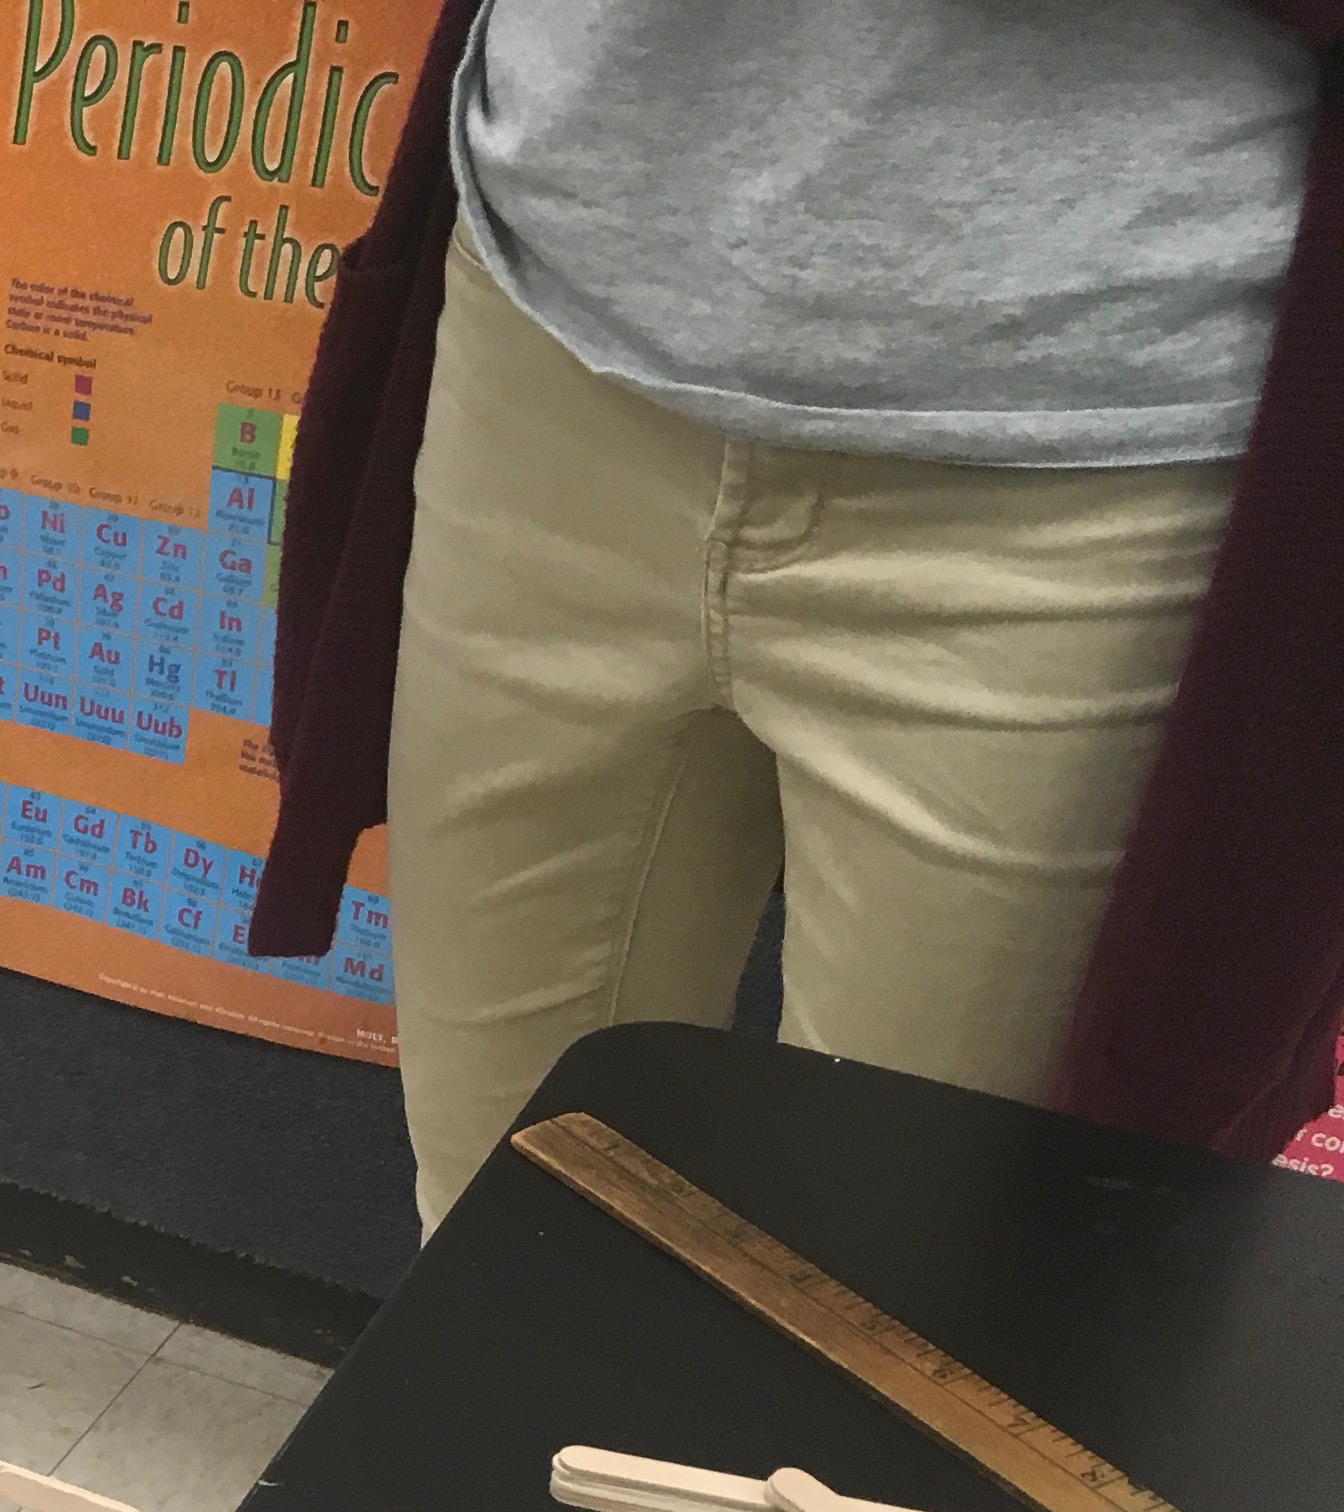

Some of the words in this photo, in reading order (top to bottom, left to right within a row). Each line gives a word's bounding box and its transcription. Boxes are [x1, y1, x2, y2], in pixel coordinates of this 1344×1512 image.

[12, 0, 400, 197] Periodic
[158, 195, 232, 291] of
[239, 205, 340, 309] the
[4, 343, 54, 362] Chemical
[240, 422, 256, 444] B
[228, 487, 255, 510] Al
[41, 511, 65, 532] Ni
[96, 523, 127, 547] Cu
[157, 535, 187, 558] Zn
[220, 551, 252, 574] Ga
[37, 569, 66, 592] Pd
[94, 583, 123, 611] Ag
[153, 597, 184, 620] Cd
[220, 610, 242, 633] In
[37, 628, 60, 649] Pt
[90, 642, 120, 664] Au
[148, 654, 182, 683] Hg
[215, 669, 236, 690] Tl
[23, 684, 68, 709] Uun
[80, 697, 124, 724] Uuu
[136, 712, 183, 738] Uub
[21, 800, 48, 822] Eu
[73, 815, 105, 838] Gd
[132, 831, 157, 853] Tb
[7, 856, 46, 879] Am
[184, 848, 214, 878] Dy
[64, 871, 99, 895] Cm
[122, 888, 148, 912] Bk
[178, 908, 202, 928] Cf
[353, 901, 389, 928] Tm
[344, 958, 384, 981] Md
[1007, 1417, 1031, 1433] 7
[1081, 1467, 1105, 1483] 8
